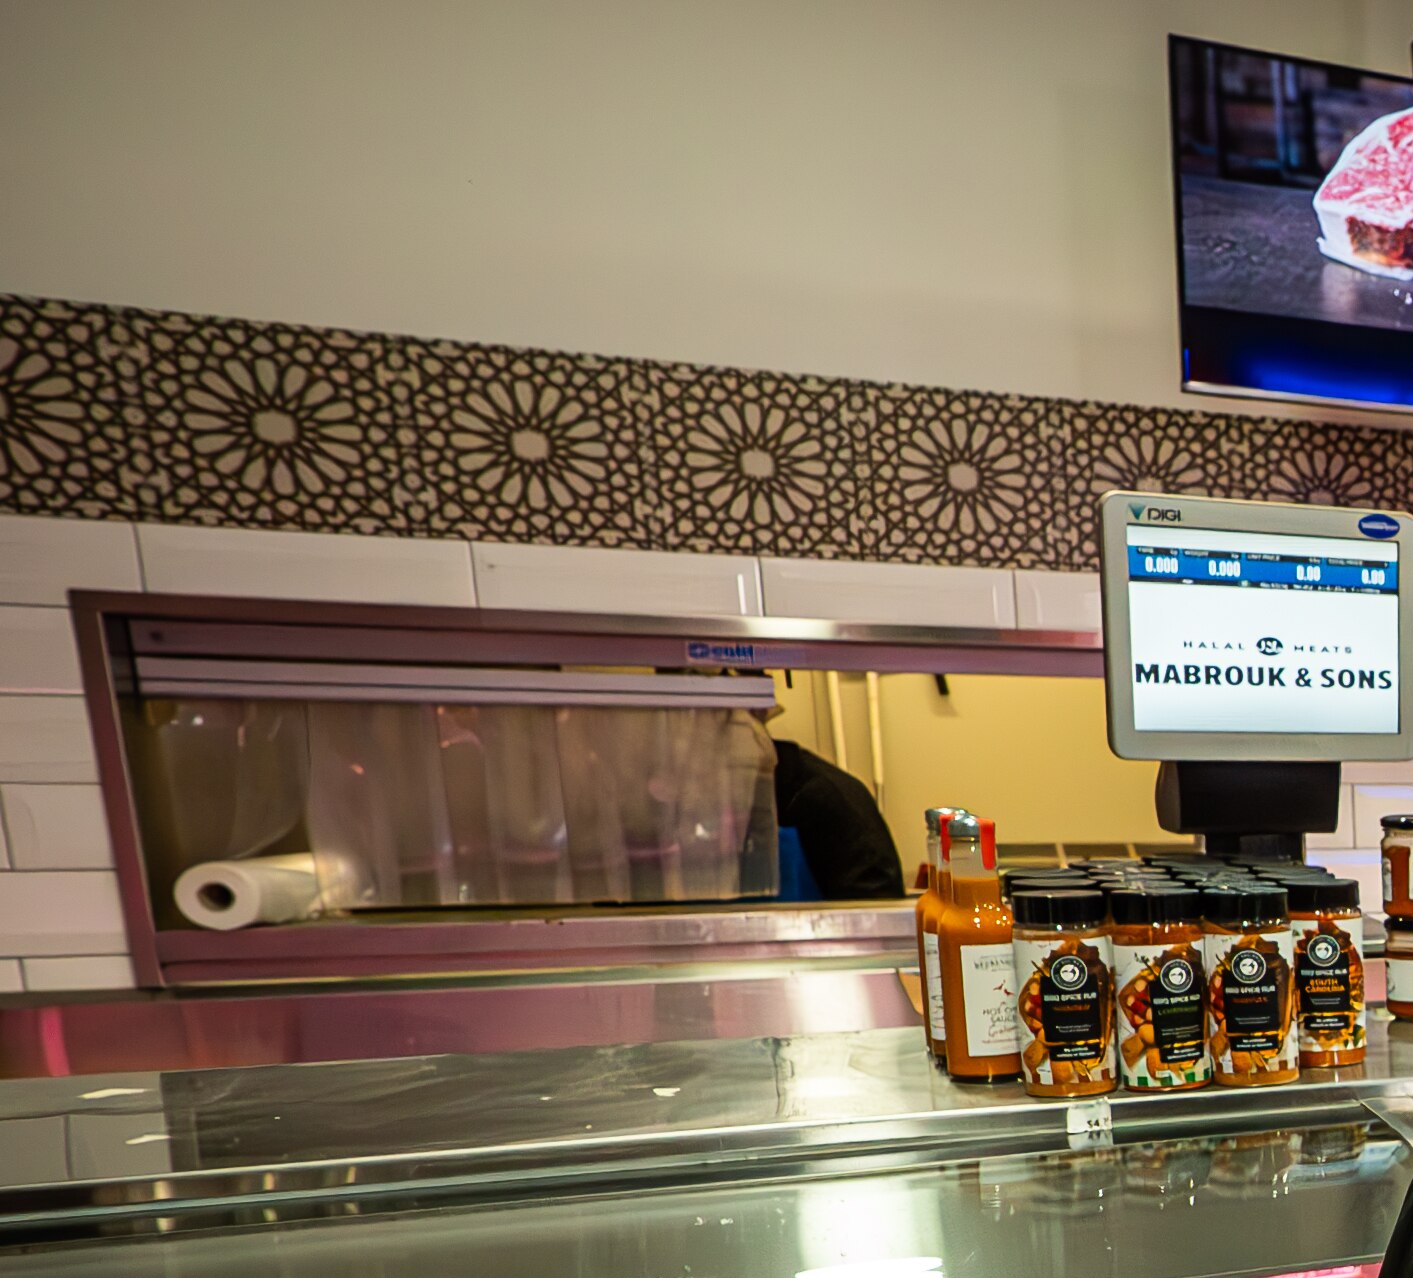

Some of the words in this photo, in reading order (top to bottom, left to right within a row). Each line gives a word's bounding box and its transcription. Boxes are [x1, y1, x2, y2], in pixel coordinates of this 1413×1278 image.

[1147, 507, 1182, 522] DIGI
[1145, 556, 1179, 574] 0.000
[1208, 560, 1241, 578] 0.000
[1296, 565, 1321, 582] 0.00
[1361, 568, 1386, 586] 0.00
[1183, 640, 1246, 650] HALAL
[1294, 645, 1353, 654] MEATS
[1135, 663, 1287, 688] MABROUK
[1295, 668, 1312, 687] &
[1320, 668, 1393, 690] SONS
